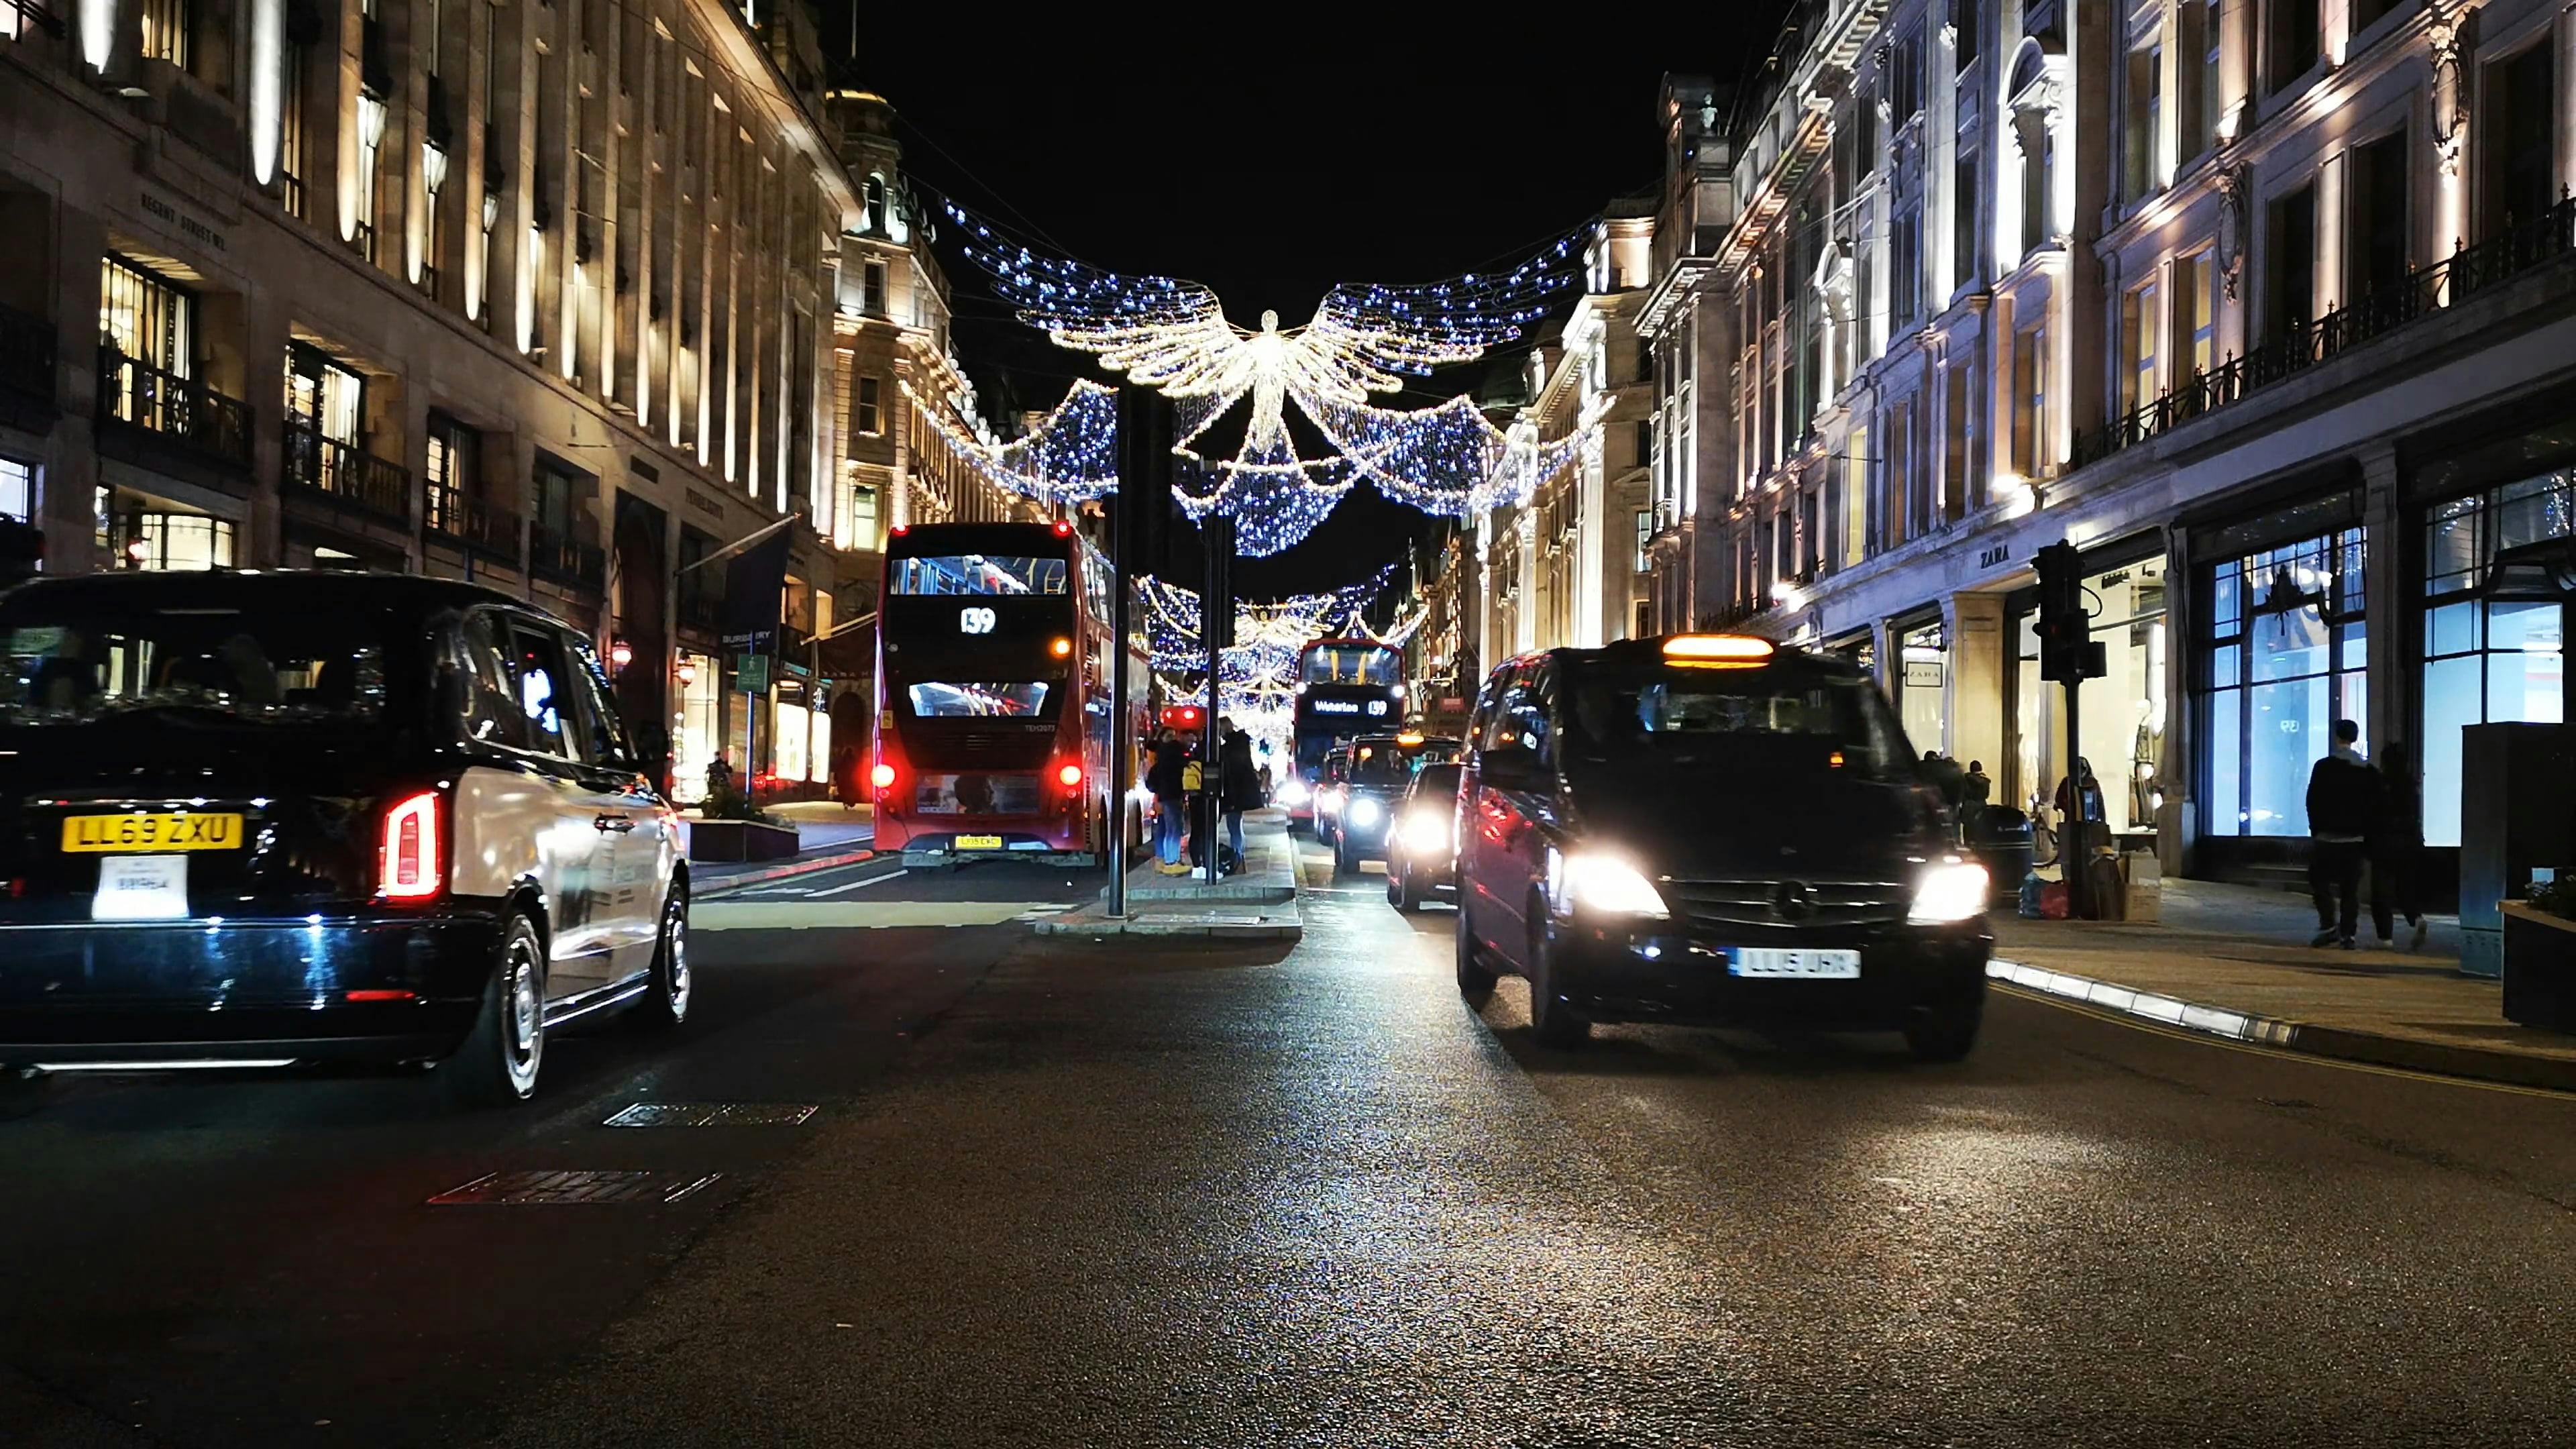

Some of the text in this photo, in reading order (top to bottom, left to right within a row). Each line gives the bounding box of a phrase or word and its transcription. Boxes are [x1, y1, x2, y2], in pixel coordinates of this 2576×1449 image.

[1980, 544, 2010, 570] ZARA
[961, 606, 996, 634] 139
[722, 631, 771, 643] BURBRY
[1314, 700, 1387, 716] Waterloo 139
[76, 816, 230, 845] LL69 ZXU
